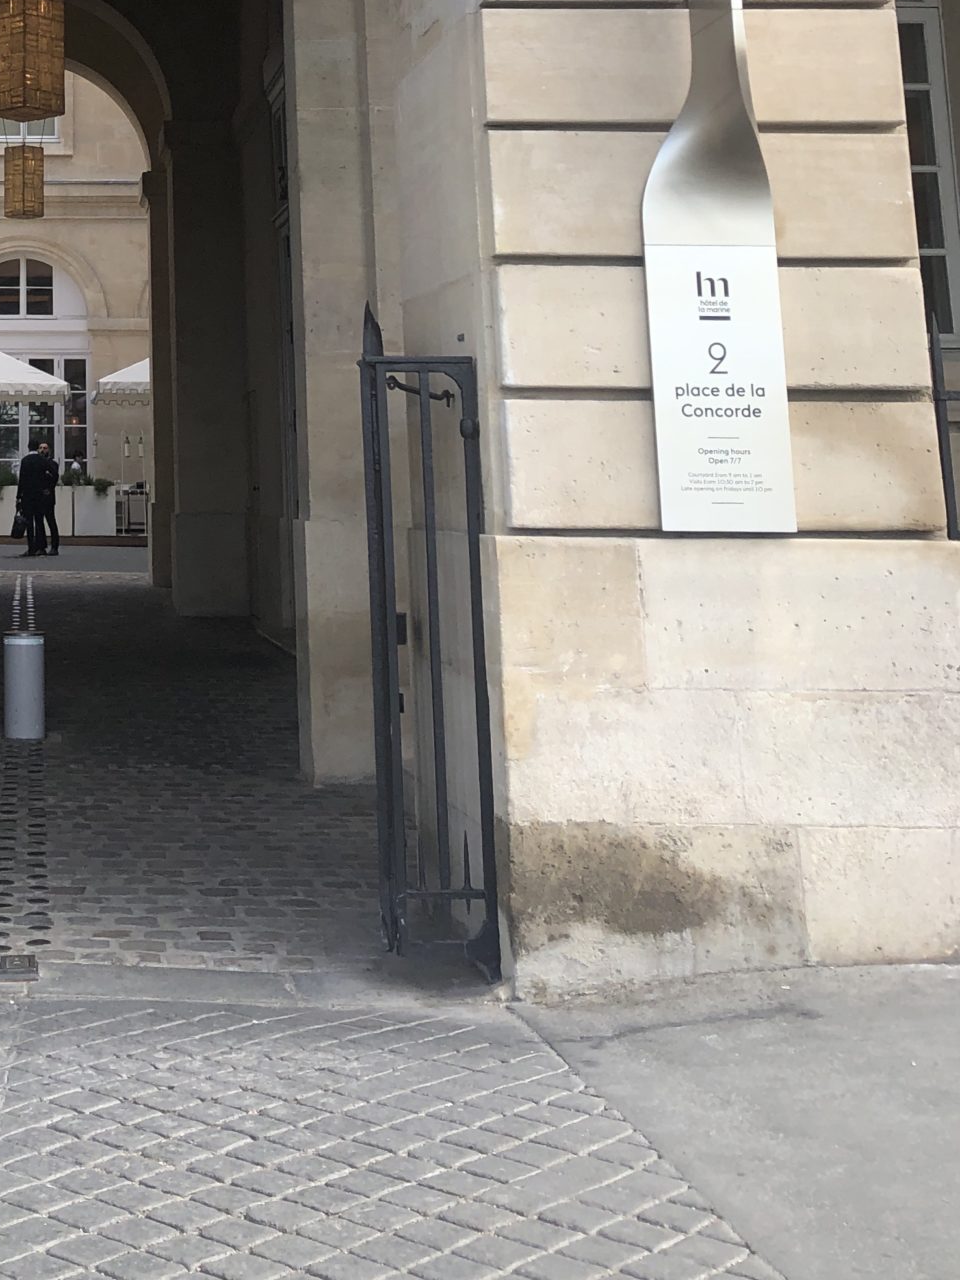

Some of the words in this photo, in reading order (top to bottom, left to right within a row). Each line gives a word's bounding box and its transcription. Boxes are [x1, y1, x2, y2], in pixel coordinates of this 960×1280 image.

[708, 342, 728, 374] 2
[675, 383, 720, 400] place
[725, 383, 746, 397] de
[751, 383, 766, 397] la
[681, 403, 762, 418] Concorde
[697, 448, 730, 456] Opening
[708, 457, 729, 465] Open
